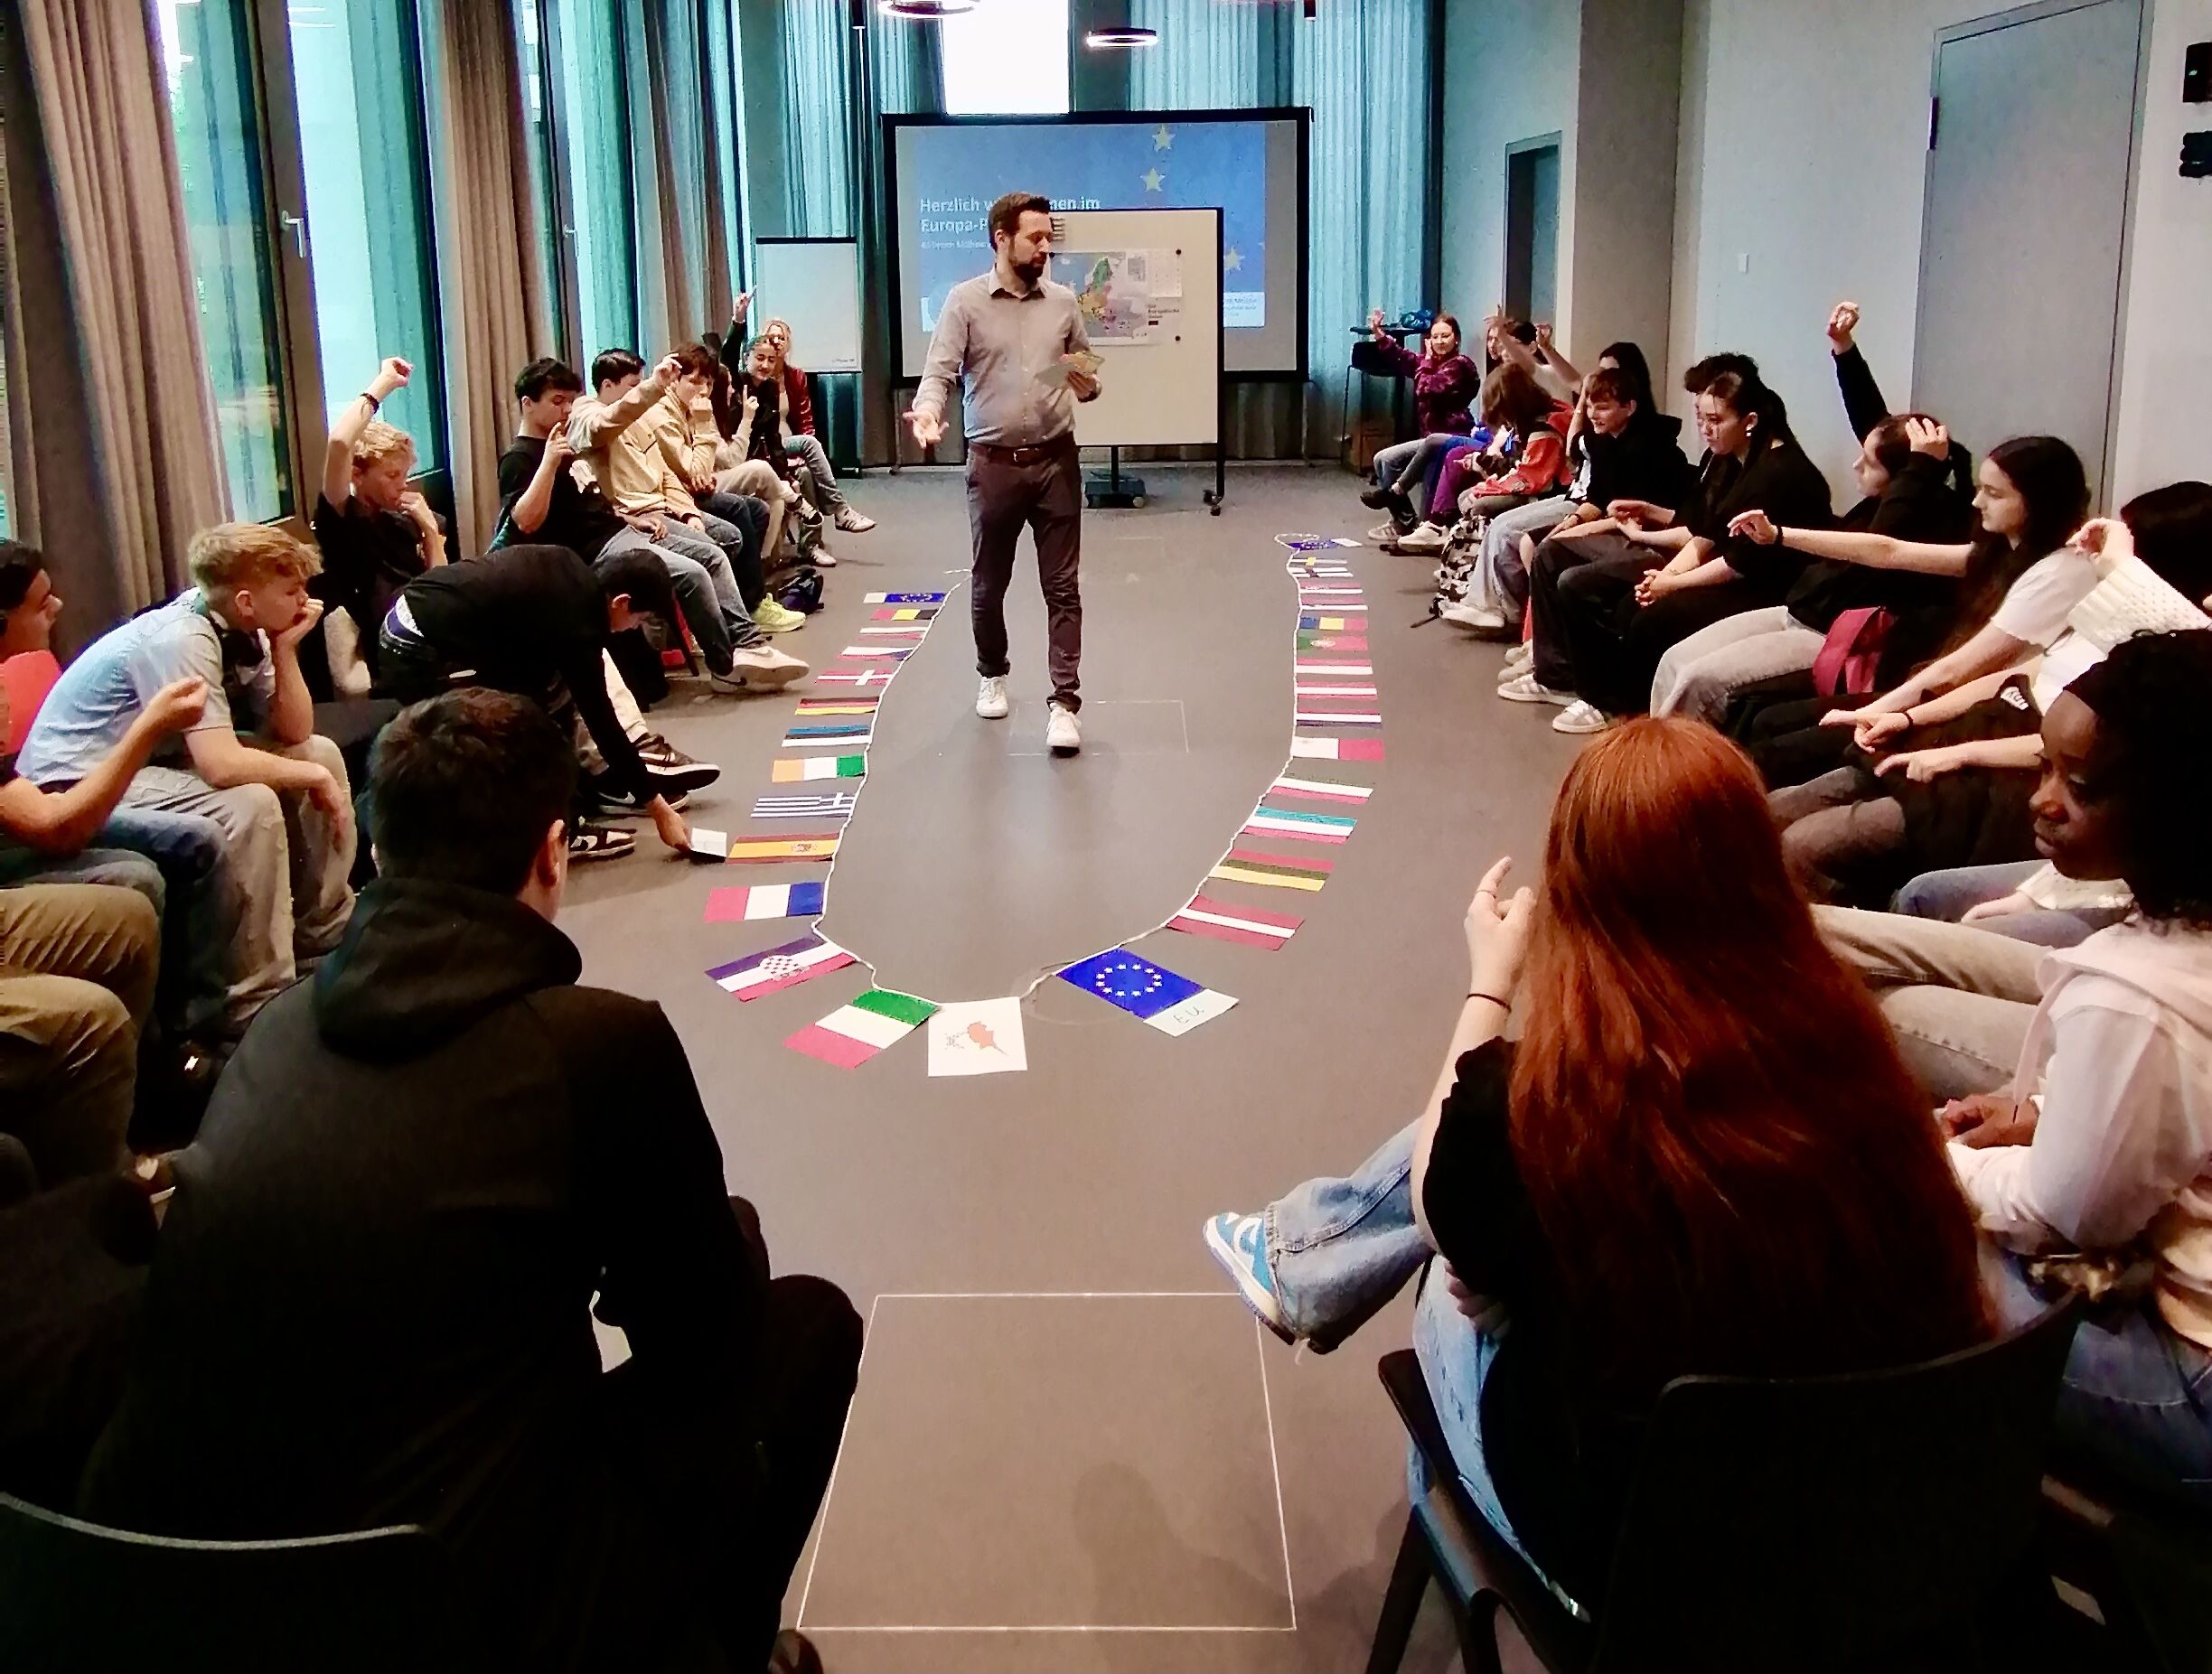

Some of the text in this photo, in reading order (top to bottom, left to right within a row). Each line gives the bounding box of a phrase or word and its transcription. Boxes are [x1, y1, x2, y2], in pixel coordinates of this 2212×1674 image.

[921, 197, 979, 212] Herzlich
[1081, 196, 1101, 210] im
[921, 218, 989, 235] Europa-P
